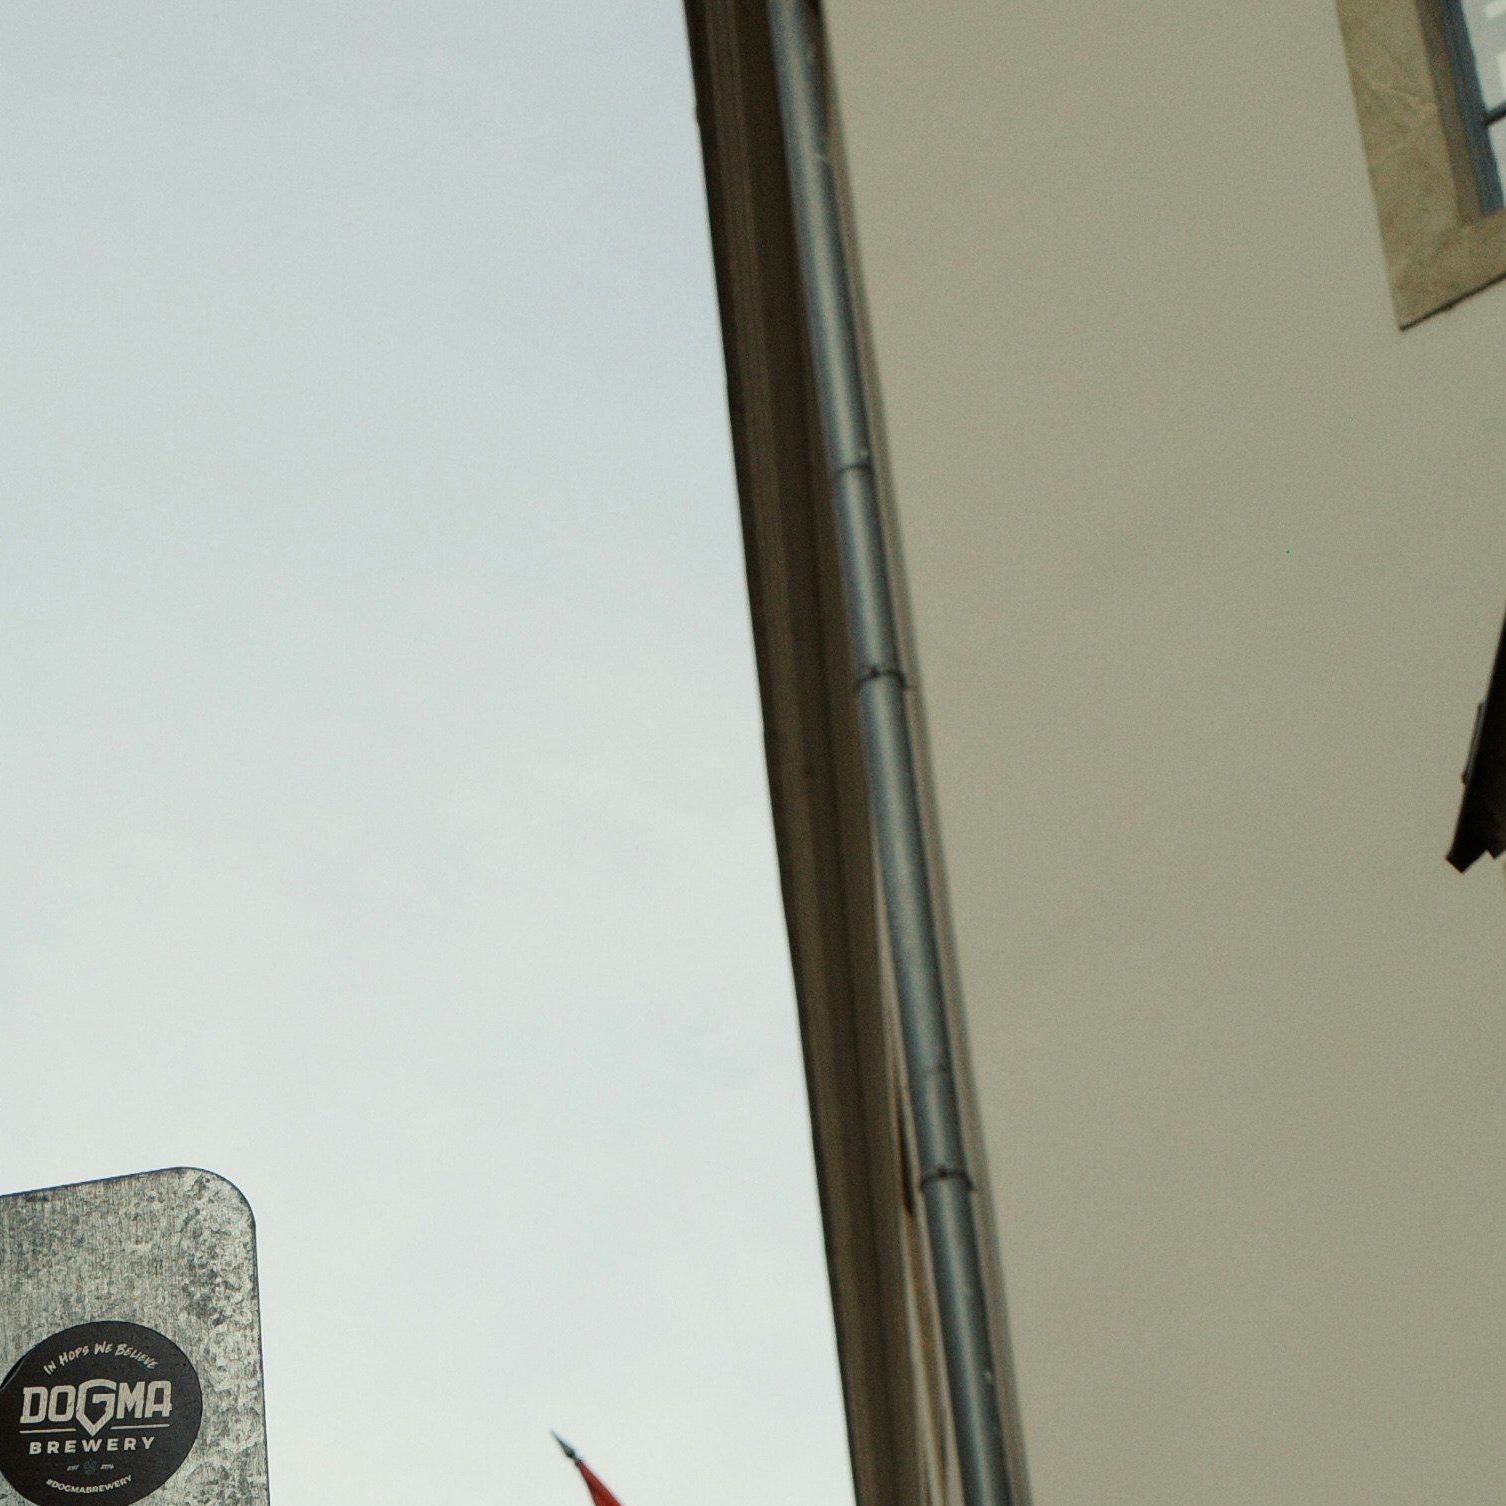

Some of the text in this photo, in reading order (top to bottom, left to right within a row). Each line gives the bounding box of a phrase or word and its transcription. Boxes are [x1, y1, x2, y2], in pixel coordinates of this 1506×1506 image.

[58, 1345, 91, 1367] HOPS
[94, 1340, 114, 1356] WE
[114, 1342, 159, 1370] BELIEVE
[19, 1378, 173, 1437] DOGMA
[27, 1435, 155, 1456] BREWERY
[45, 1473, 133, 1495] #DOGMABREWERY
